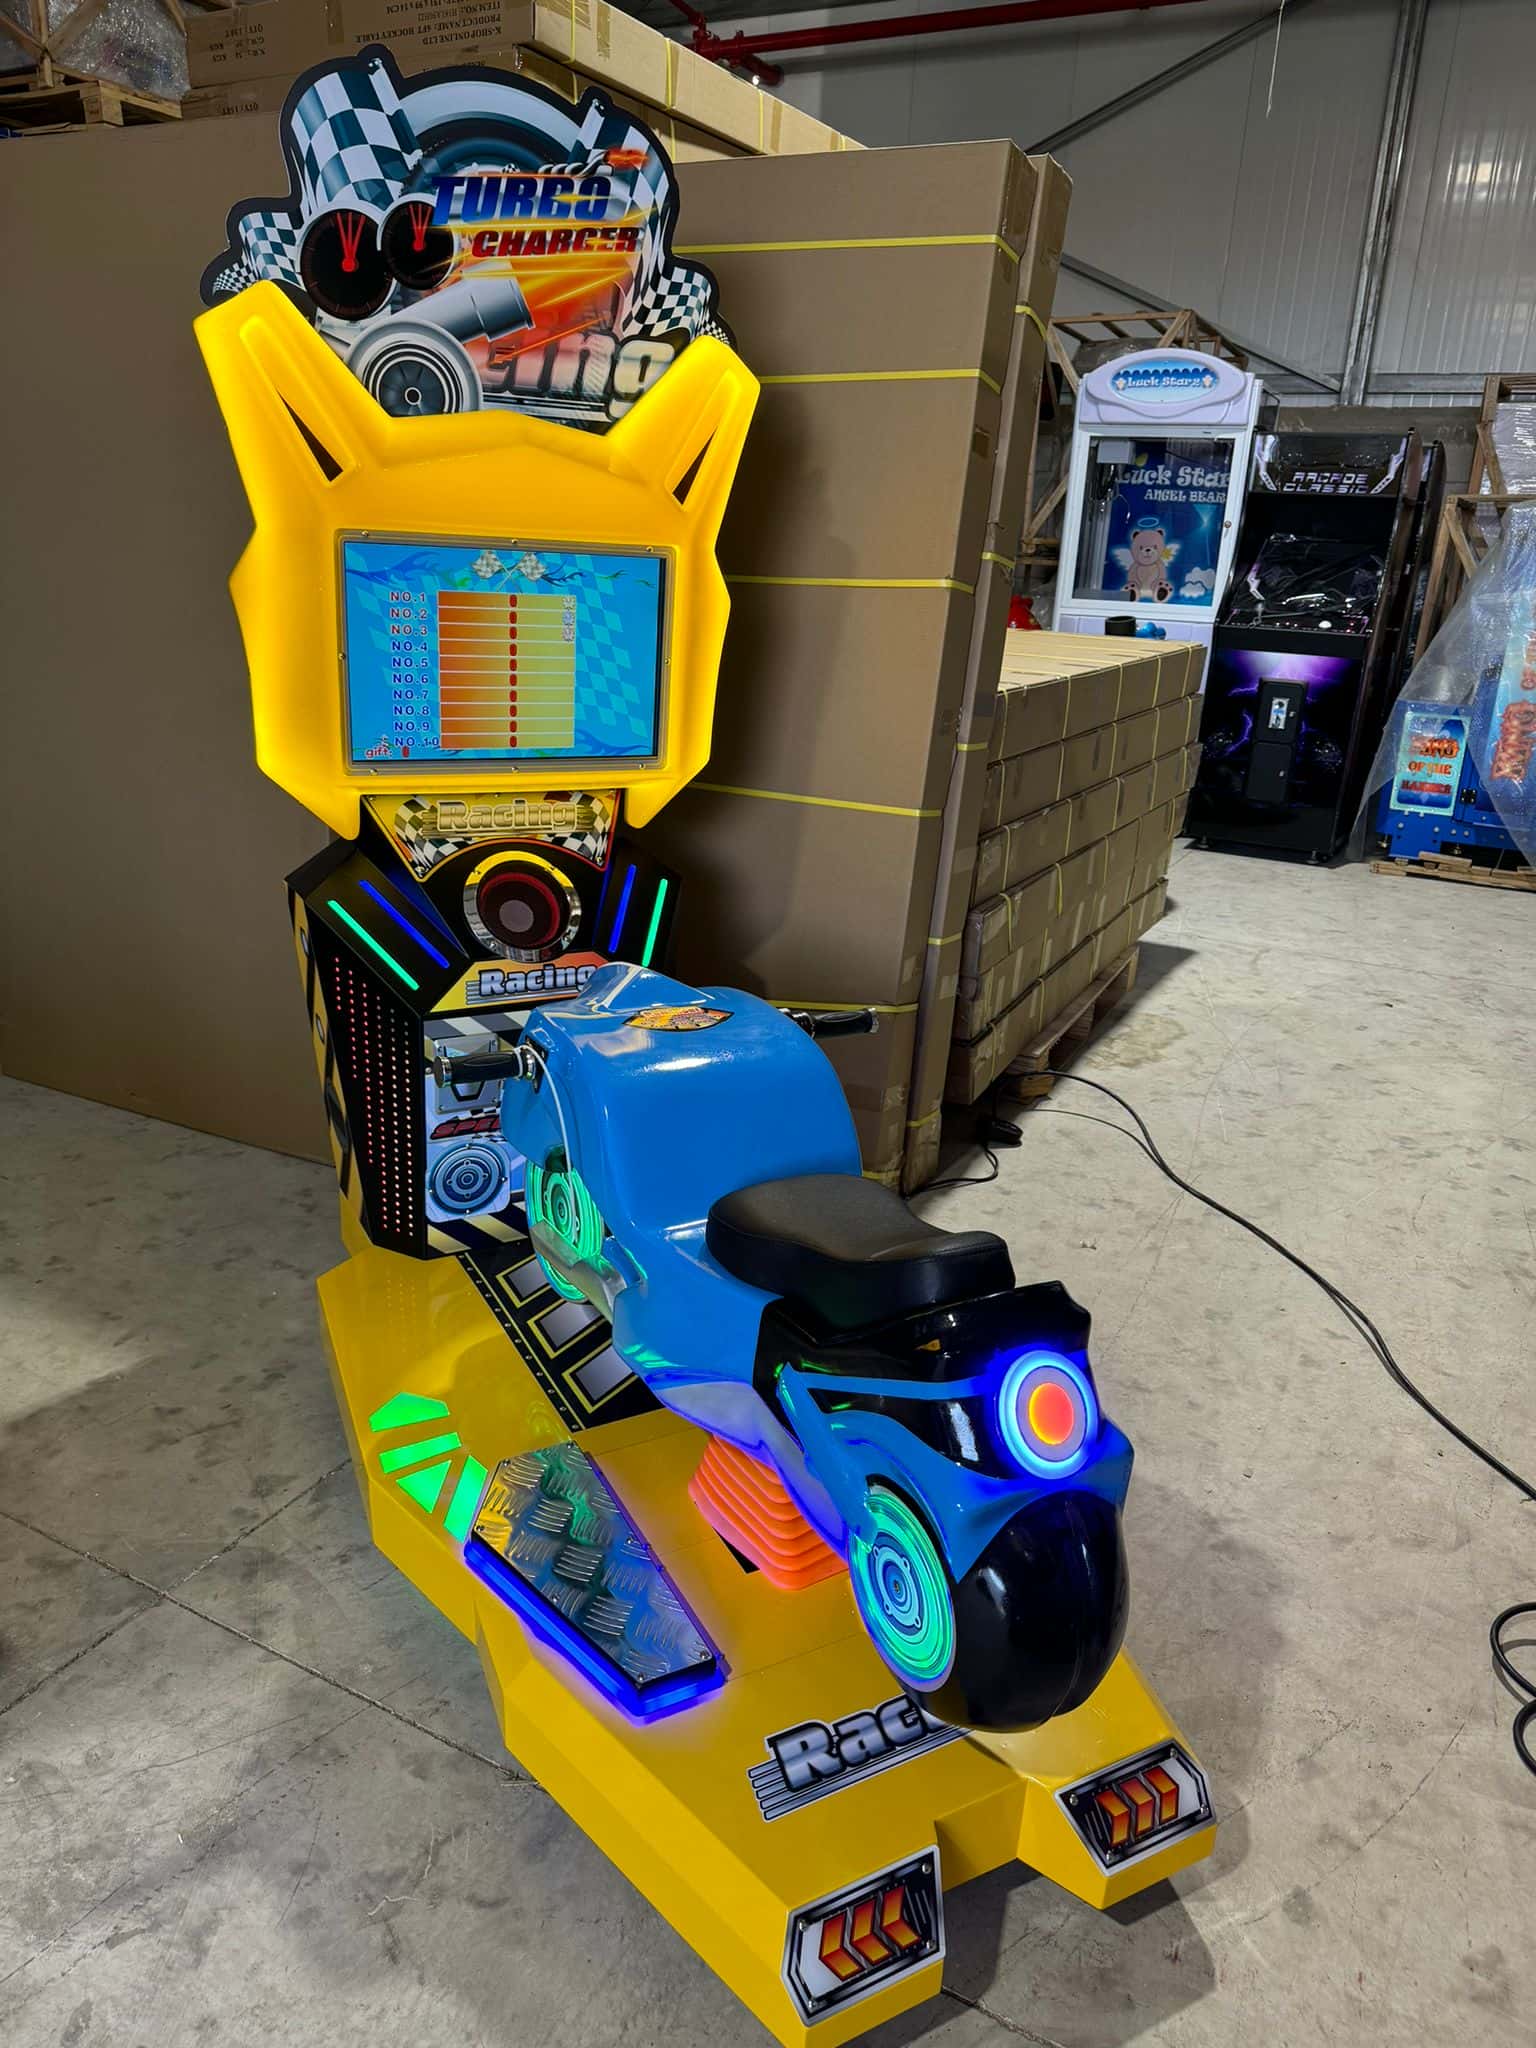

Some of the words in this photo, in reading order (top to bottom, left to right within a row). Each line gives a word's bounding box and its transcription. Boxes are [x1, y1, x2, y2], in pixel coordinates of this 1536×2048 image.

[431, 175, 612, 226] TURBO
[471, 227, 641, 257] CHARGER
[1127, 376, 1159, 388] Luck
[1115, 464, 1172, 486] Luck
[1292, 472, 1369, 484] ARCADE
[1144, 488, 1187, 502] ANGEL
[437, 800, 577, 832] Racing
